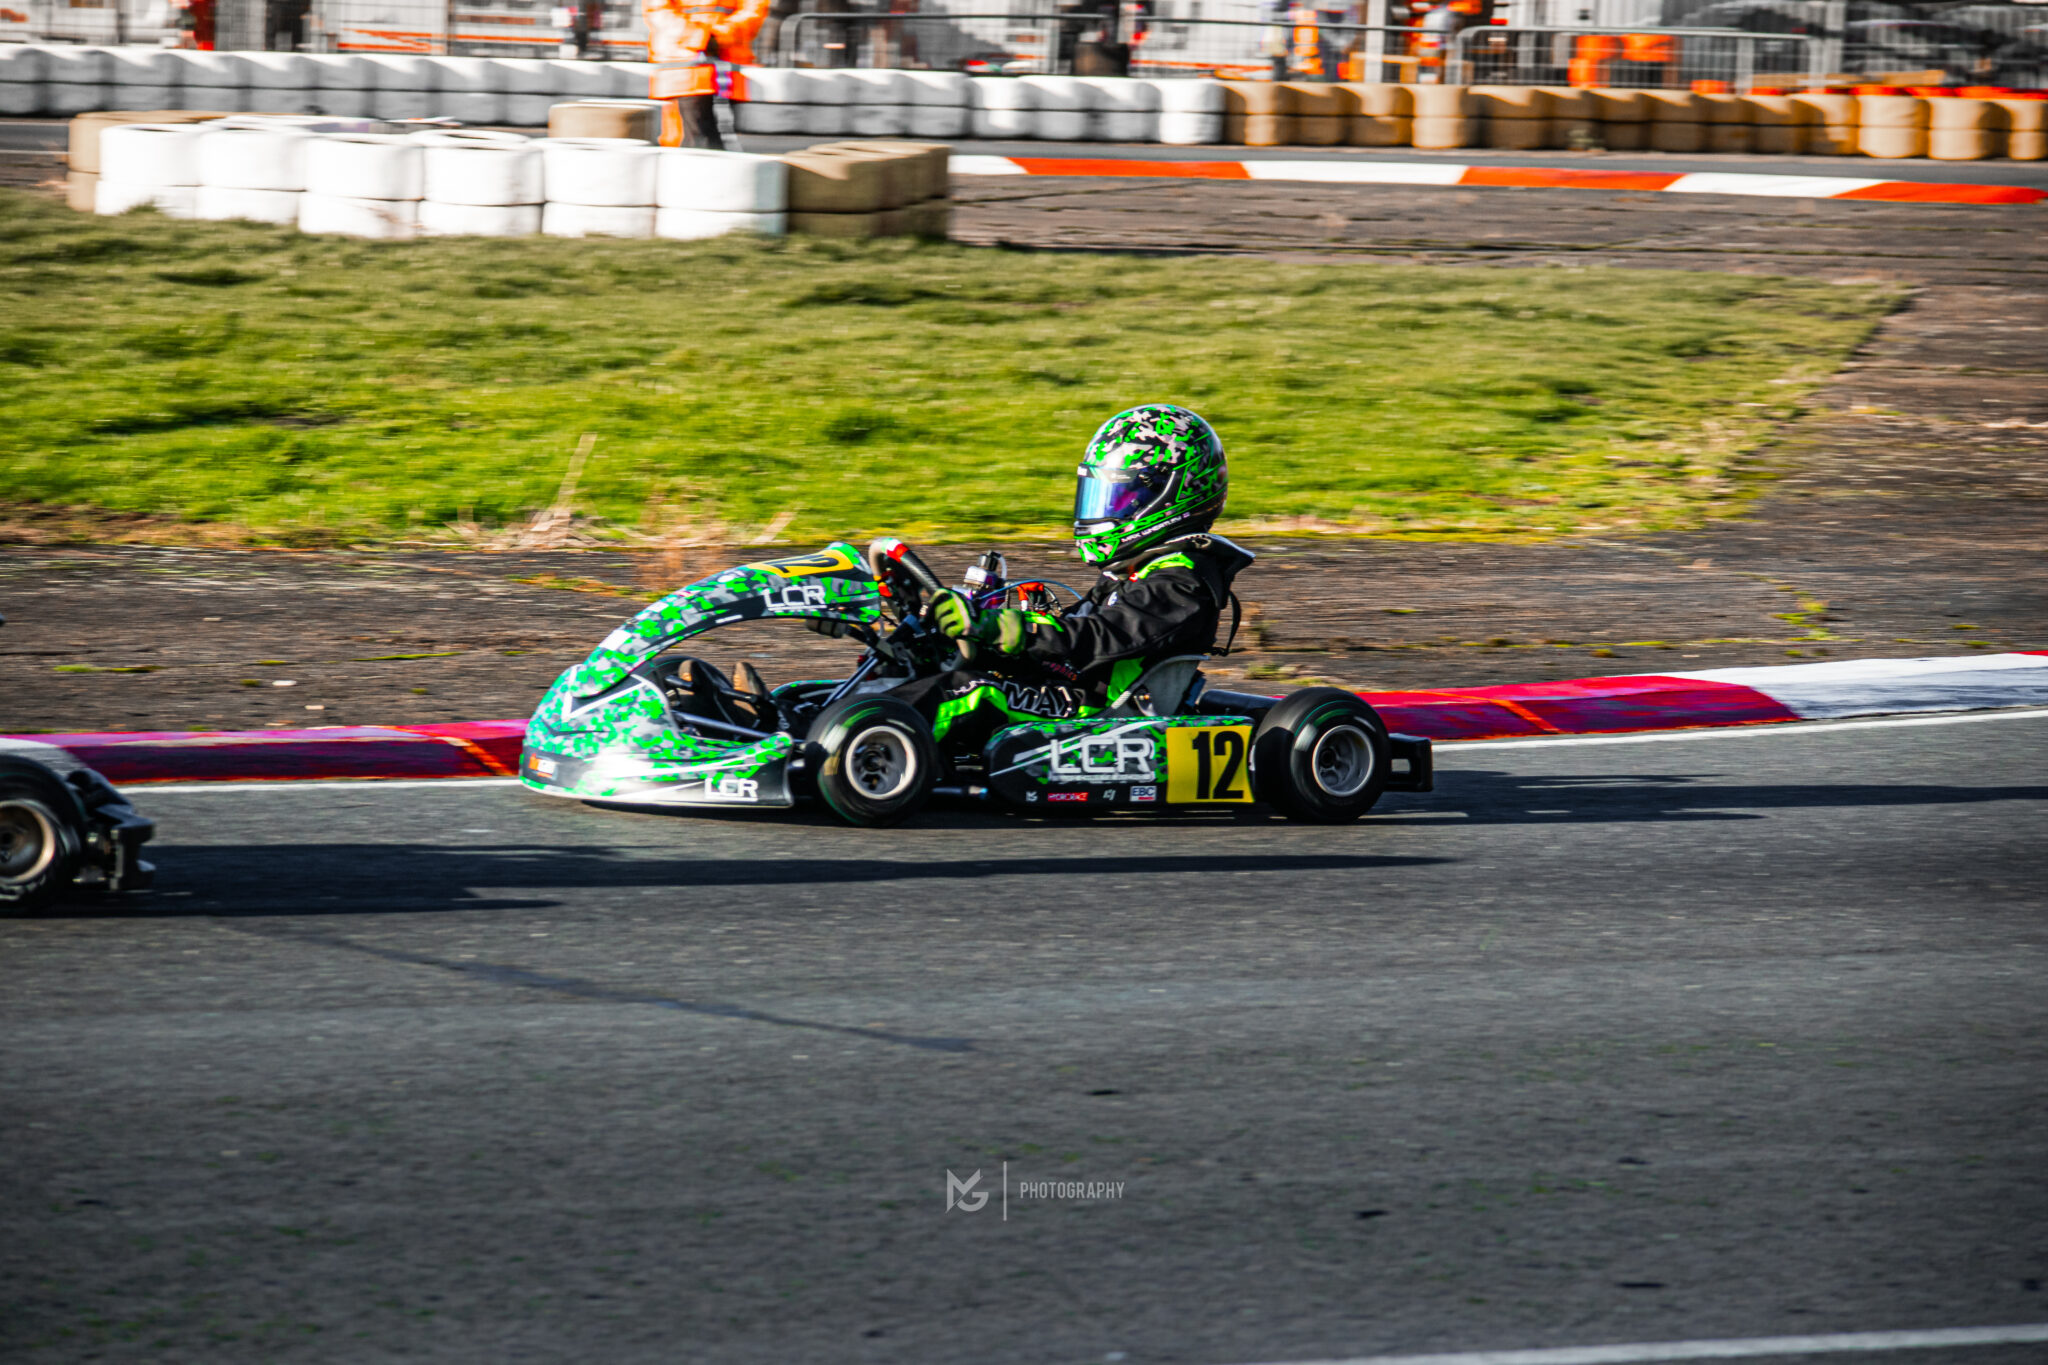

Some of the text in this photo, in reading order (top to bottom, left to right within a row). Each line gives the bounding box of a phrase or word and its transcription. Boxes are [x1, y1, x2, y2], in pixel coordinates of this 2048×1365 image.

[761, 585, 826, 606] LCR
[1050, 735, 1153, 774] LCR
[1192, 731, 1244, 800] 12
[705, 777, 758, 798] LCR
[1132, 787, 1156, 797] EBC
